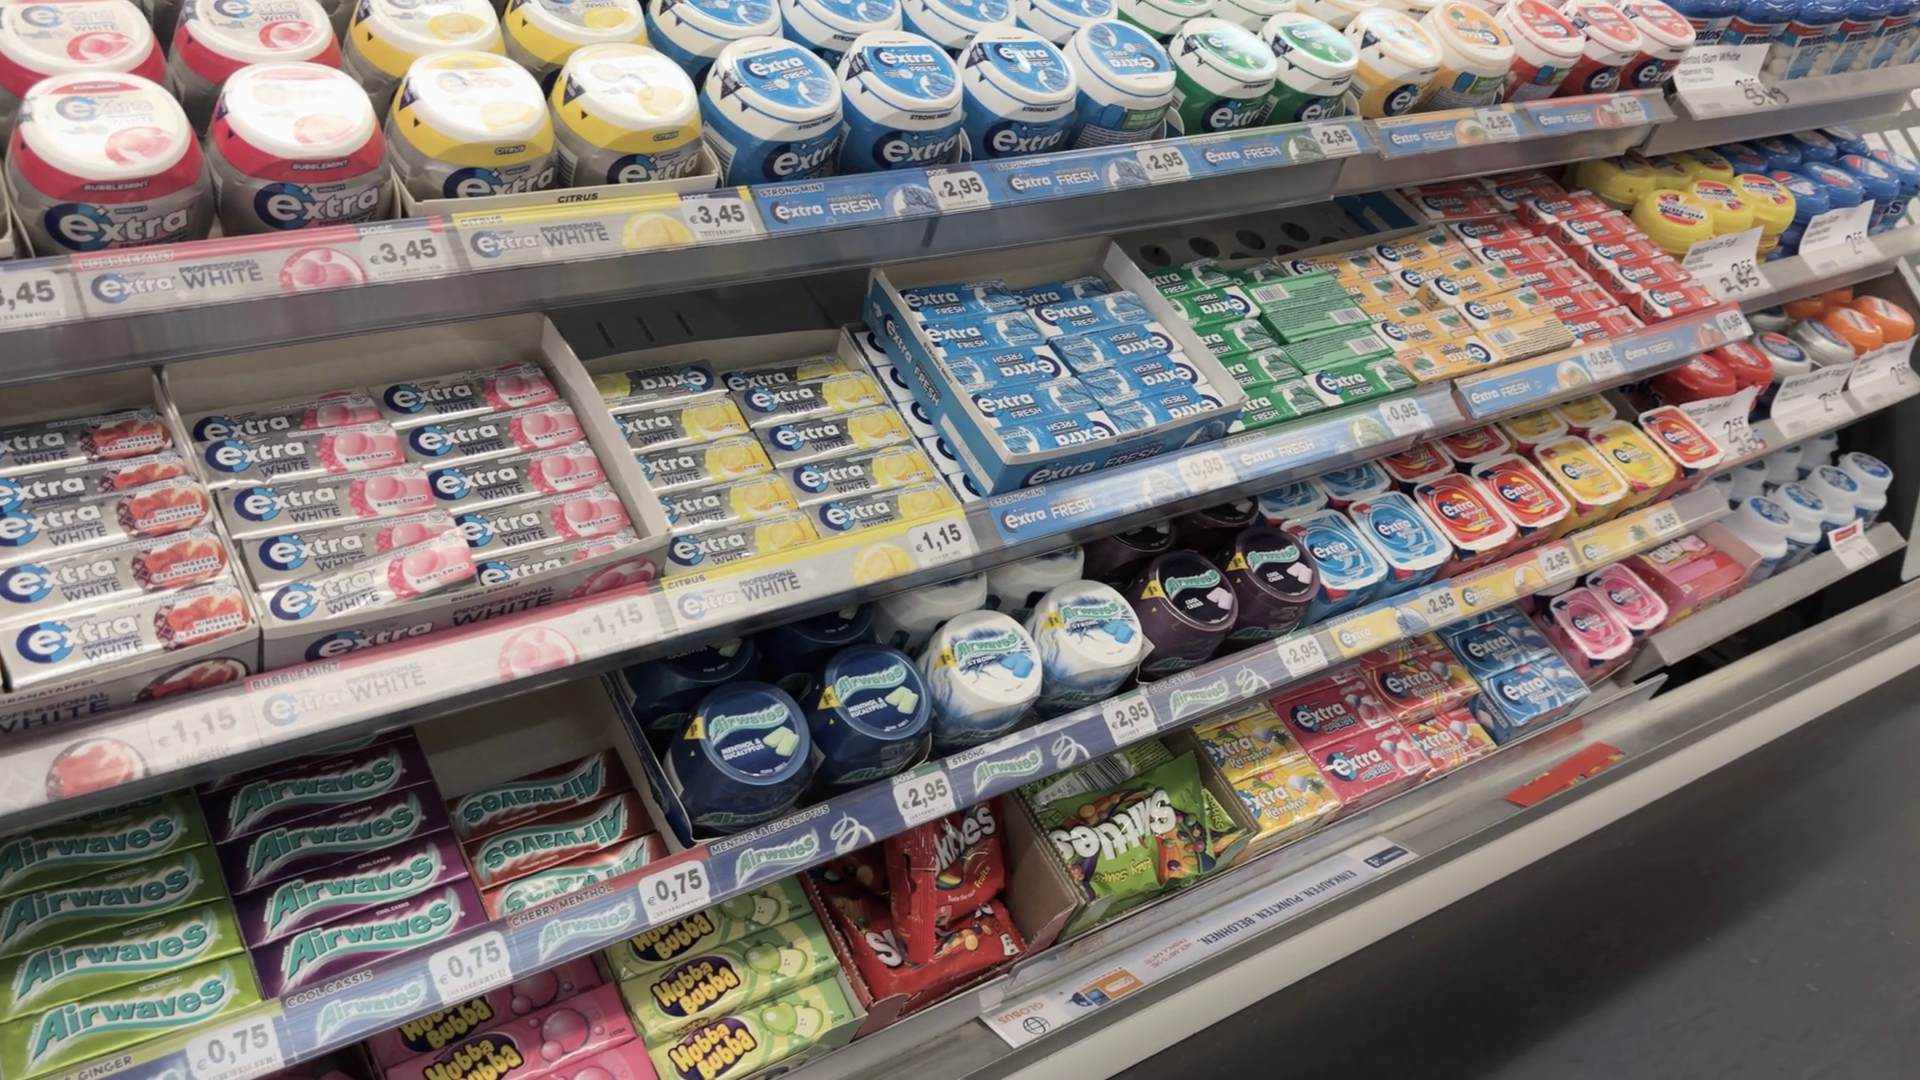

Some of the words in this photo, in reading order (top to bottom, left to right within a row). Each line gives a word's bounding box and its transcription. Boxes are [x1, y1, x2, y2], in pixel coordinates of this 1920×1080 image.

[880, 51, 934, 65] extra
[1720, 51, 1741, 62] White
[783, 69, 813, 80] FRESH
[909, 64, 941, 73] FRESH
[654, 132, 679, 141] CITRUS
[1391, 131, 1421, 145] extra
[1423, 129, 1454, 142] FRESH
[495, 145, 526, 155] CITRUS
[1205, 147, 1241, 162] extra
[1243, 145, 1282, 159] FRESH
[292, 159, 349, 171] BUBBLEMINT
[925, 168, 948, 177] DOSE
[84, 180, 150, 192] BUBBLEMINT
[1011, 174, 1052, 190] extra
[1056, 170, 1100, 187] FRESH
[558, 192, 599, 204] CITRUS
[759, 187, 795, 198] STRONG
[797, 183, 825, 194] MINT
[775, 203, 825, 222] extra
[829, 199, 882, 216] FRESH
[459, 215, 504, 228] CITRUS
[540, 221, 603, 236] PROFESSIONAL
[478, 232, 539, 253] extra
[542, 229, 610, 248] WHITE
[1384, 244, 1418, 260] extra
[178, 259, 260, 274] PROFESSIONAL
[181, 265, 264, 289] WHITE
[1441, 276, 1476, 294] extra
[101, 277, 174, 298] extra
[935, 306, 966, 315] FRESH
[1471, 302, 1508, 319] extra
[1071, 317, 1100, 327] FRESH
[957, 339, 989, 349] FRESH
[992, 353, 1023, 363] FRESH
[508, 388, 550, 402] BUBBLEMINT
[857, 394, 877, 403] CITRUS
[1350, 386, 1374, 397] FRESH
[1471, 389, 1499, 404] extra
[1502, 383, 1531, 398] FRESH
[436, 401, 480, 415] WHITE
[789, 401, 821, 415] WHITE
[1011, 407, 1042, 419] FRESH
[720, 422, 741, 431] CITRUS
[102, 440, 163, 453] GRANATAPPEL
[117, 434, 162, 445] HIMBEERE
[1278, 440, 1314, 457] FRESH
[345, 452, 396, 463] BUBBLEMINT
[260, 461, 311, 478] WHITE
[554, 471, 597, 484] BUBBLEMINT
[907, 469, 928, 479] CITRUS
[836, 478, 871, 494] WHITE
[1503, 483, 1533, 500] extra
[377, 496, 427, 508] BUBBLEMINT
[990, 492, 1023, 508] STRONG
[1025, 487, 1046, 500] MINT
[156, 504, 200, 517] HIMBEERE
[290, 507, 341, 523] WHITE
[1051, 499, 1096, 520] FRESH
[1442, 501, 1474, 517] extra
[139, 510, 203, 526] GRANATAPPEL
[577, 515, 620, 529] BUBBLEMINT
[1006, 510, 1047, 528] extra
[1379, 519, 1411, 536] extra
[173, 556, 218, 570] HIMBEERE
[155, 563, 221, 581] GRANATAPPEL
[415, 563, 468, 585] BUBBLEMINT
[739, 569, 796, 587] PROFESSIONAL
[667, 575, 706, 590] CITRUS
[741, 576, 801, 603] WHITE
[328, 593, 380, 615] WHITE
[195, 613, 241, 627] HIMBEERE
[1073, 620, 1099, 631] STRONG
[84, 639, 144, 662] WHITE
[1468, 637, 1510, 657] extra
[967, 653, 996, 666] STRONG
[252, 662, 339, 692] BUBBLEMINT
[1386, 671, 1430, 693] extra
[348, 670, 426, 702] WHITE
[1504, 679, 1546, 700] extra
[1171, 681, 1226, 711] Airwaves
[850, 702, 888, 717] EUCALYPTUS
[724, 744, 765, 760] EUCALYPTUS
[952, 749, 985, 766] STRONG
[976, 753, 1039, 787] Airwaves
[1260, 772, 1275, 783] NEU
[711, 836, 759, 855] MENTHOL
[767, 804, 830, 834] EUCALYPTUS
[251, 803, 414, 878] Airwaves
[485, 808, 624, 869] Airwaves
[738, 834, 815, 878] Airwaves
[1303, 870, 1357, 897] EINKAUFEN.
[270, 852, 433, 935] Airwaves
[4, 867, 190, 941] Airwaves
[512, 905, 557, 927] CHERRY
[558, 884, 613, 909] MENTHOL
[1252, 894, 1303, 921] PUNKTEN.
[542, 902, 631, 947] Airwaves
[1197, 918, 1256, 946] BELOHNEN.
[287, 900, 452, 981] Airwaves
[657, 915, 714, 961] Bubba
[18, 922, 207, 1000] Airwaves
[286, 985, 324, 1009] COOL
[326, 971, 374, 995] CASSIS
[651, 959, 714, 1008] Hubba
[680, 966, 739, 1016] Bubba
[31, 978, 225, 1062] Airwaves
[997, 1001, 1045, 1025] GLOBUS
[670, 1018, 731, 1074] Hubba
[698, 1029, 757, 1080] Bubba
[78, 1056, 133, 1080] GINGER
